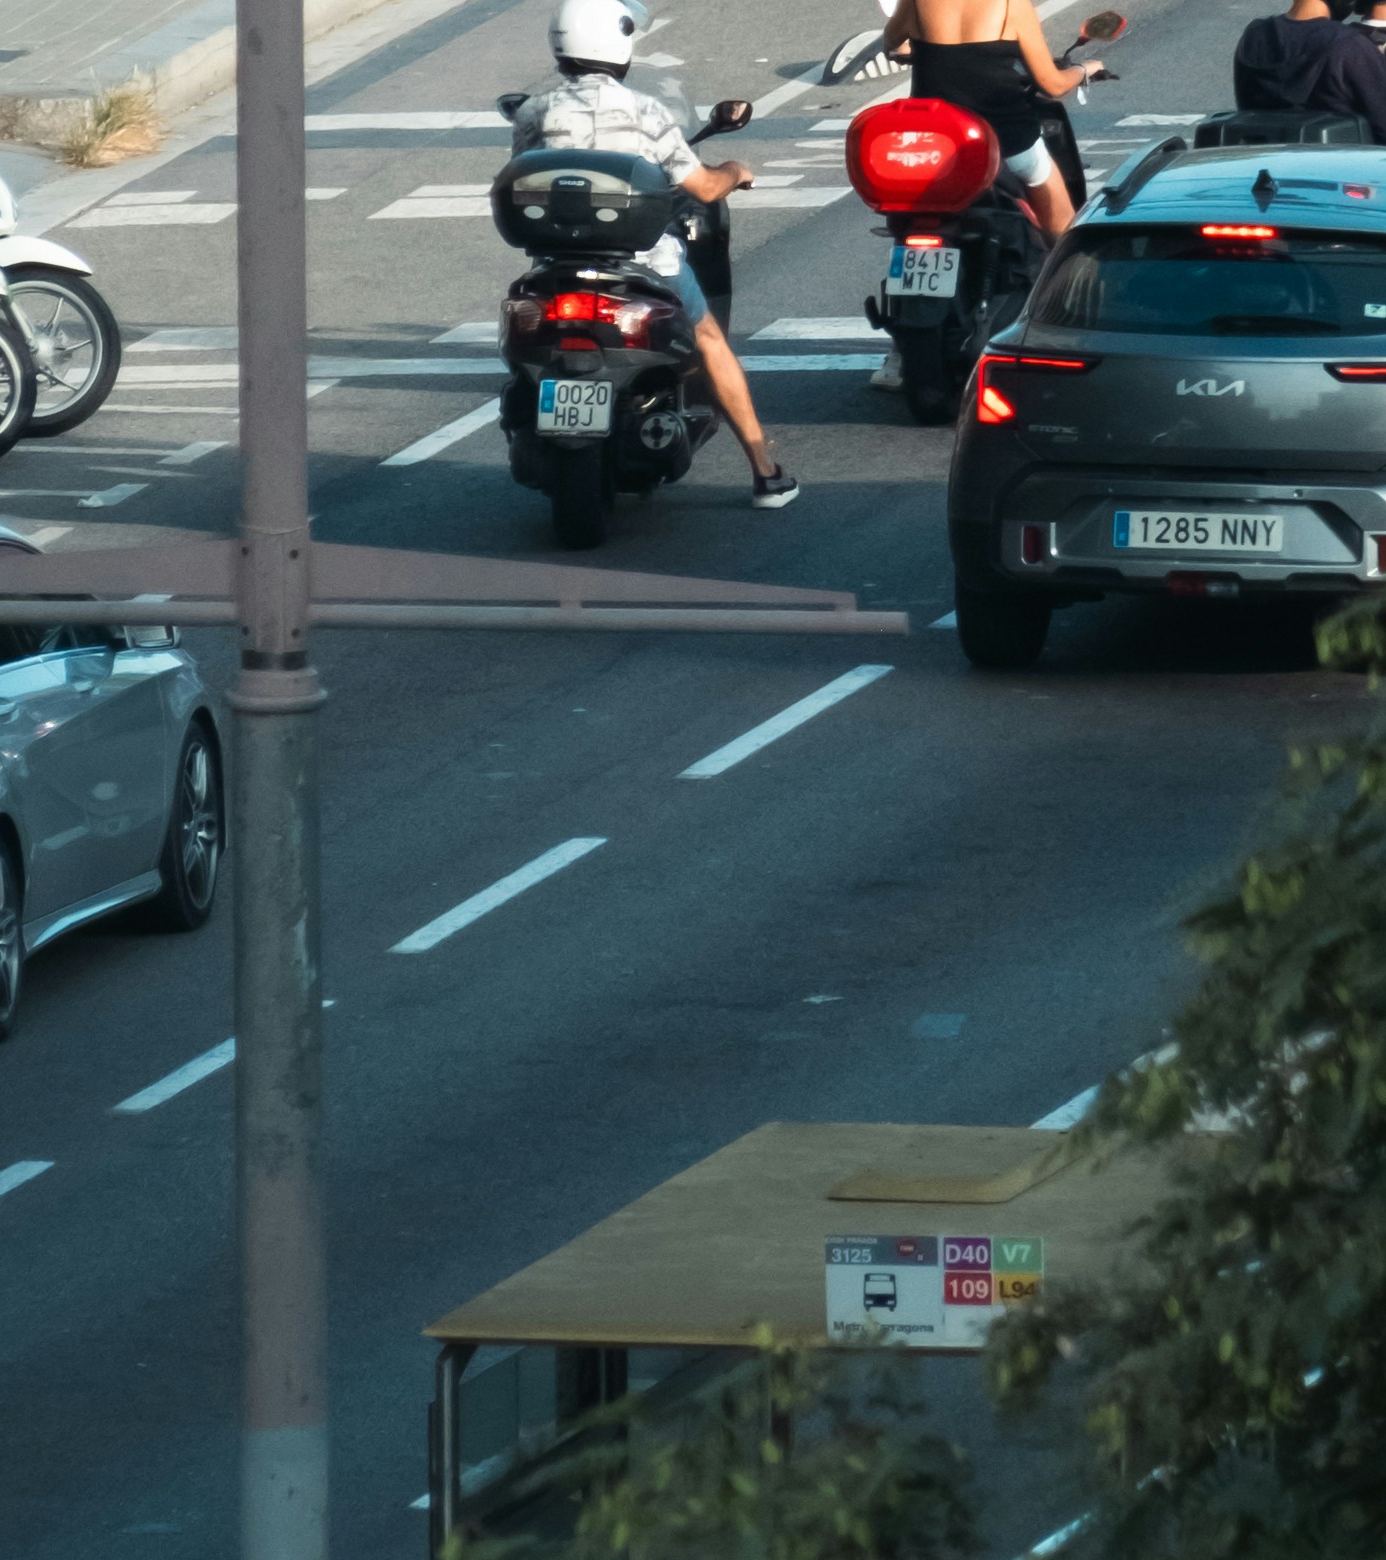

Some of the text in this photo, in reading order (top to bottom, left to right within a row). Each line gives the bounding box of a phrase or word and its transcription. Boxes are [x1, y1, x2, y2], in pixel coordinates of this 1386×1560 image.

[904, 250, 954, 271] 8415
[902, 271, 940, 291] MTC
[557, 384, 608, 406] 0020
[554, 406, 594, 426] HBJ
[1140, 516, 1210, 544] 1285
[1221, 518, 1277, 546] NNY
[831, 1247, 873, 1263] 3125
[945, 1244, 989, 1264] D40
[1001, 1244, 1032, 1263] V7
[949, 1279, 989, 1299] 109
[999, 1280, 1036, 1299] L94
